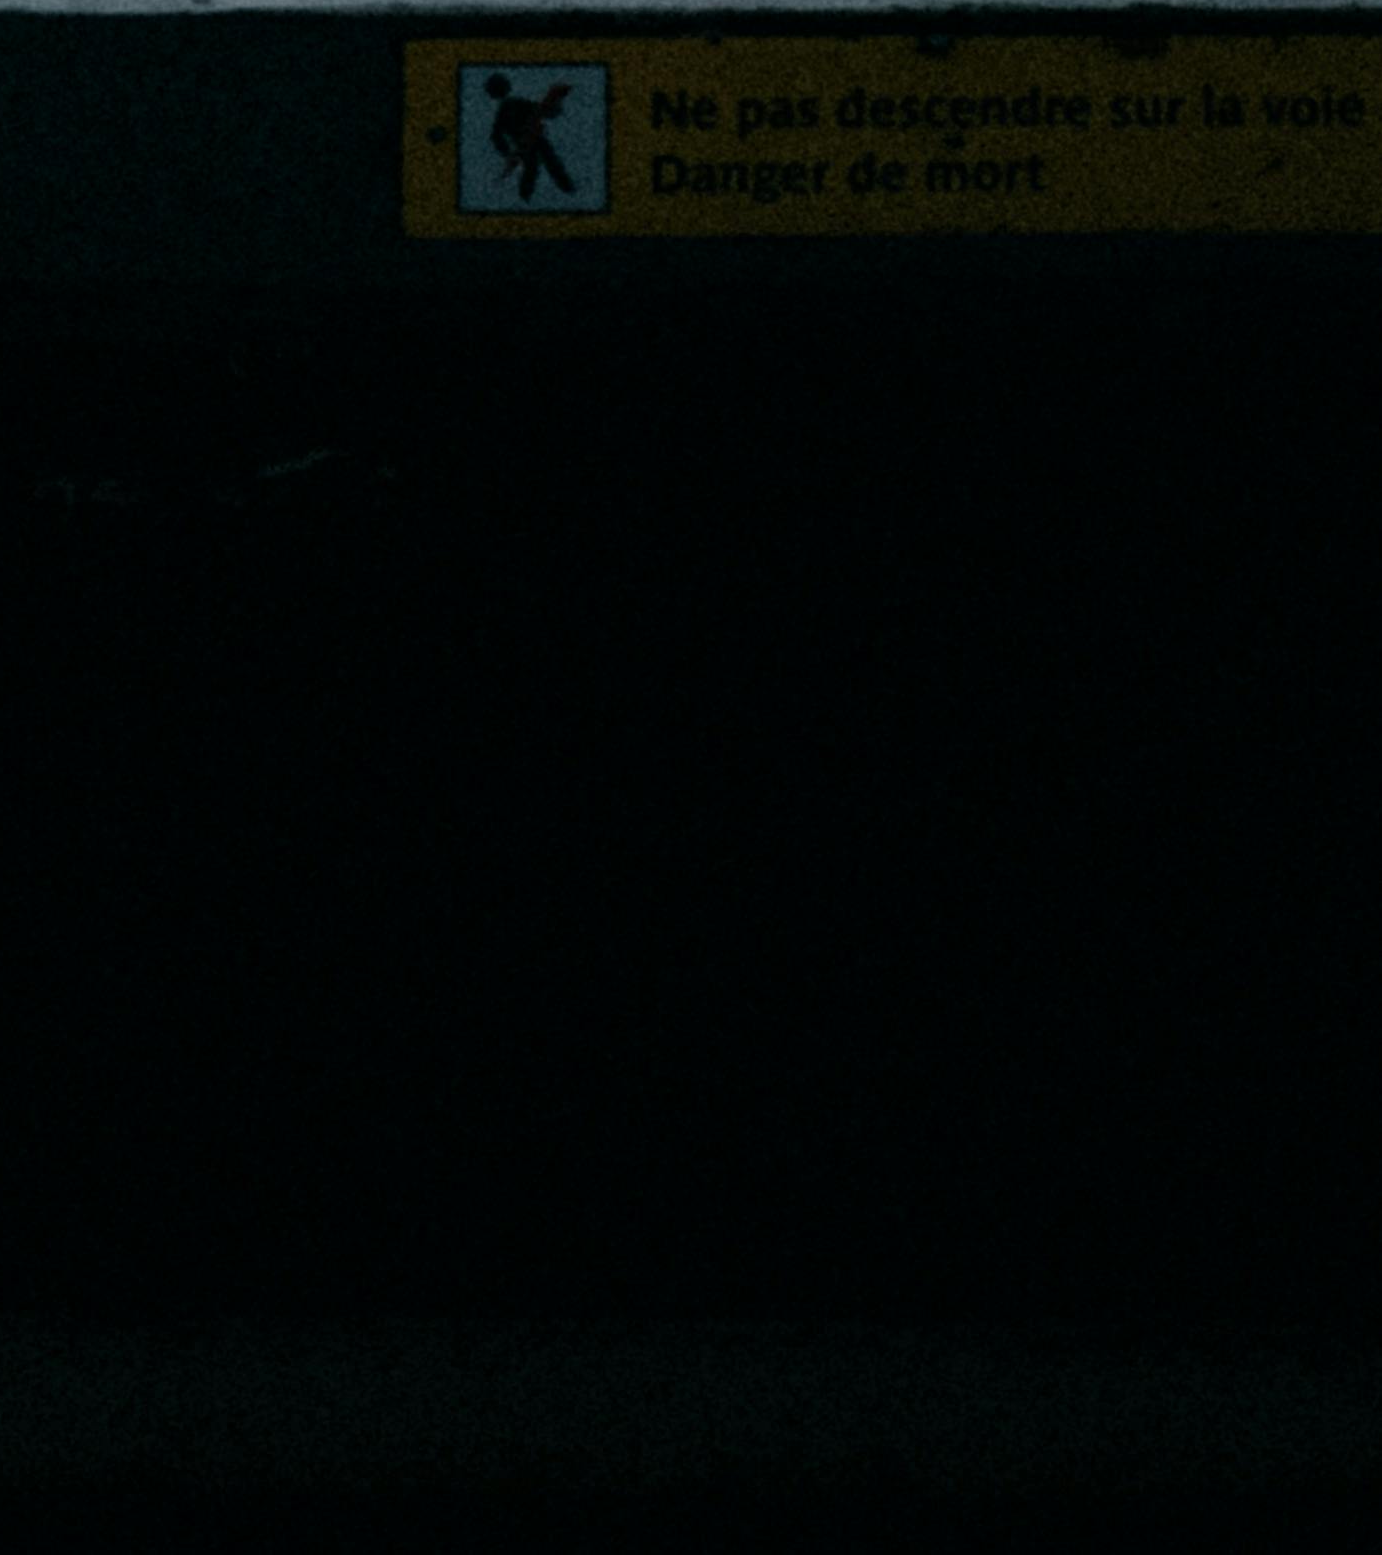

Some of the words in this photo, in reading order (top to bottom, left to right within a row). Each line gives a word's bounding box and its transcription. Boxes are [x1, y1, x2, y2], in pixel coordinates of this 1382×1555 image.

[651, 91, 718, 131] Ne
[737, 98, 820, 139] pas
[837, 86, 1092, 130] descendre
[1111, 93, 1184, 129] sur
[1201, 83, 1246, 128] la
[1264, 84, 1363, 129] voie
[651, 154, 831, 203] Danger
[849, 151, 904, 195] de
[925, 154, 1045, 195] mort
